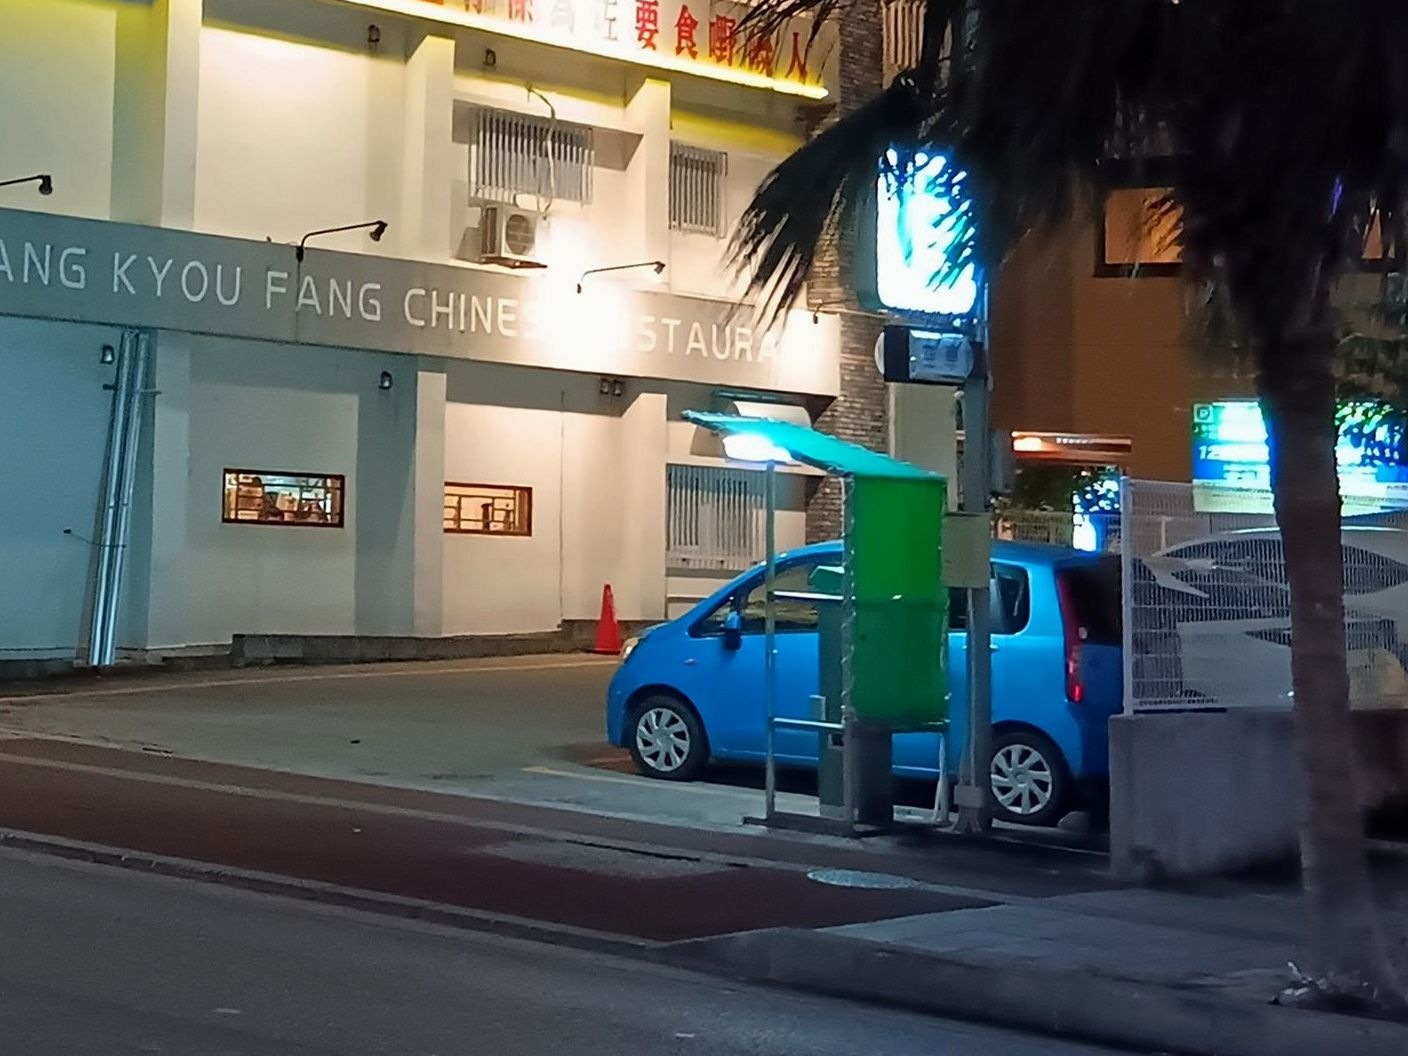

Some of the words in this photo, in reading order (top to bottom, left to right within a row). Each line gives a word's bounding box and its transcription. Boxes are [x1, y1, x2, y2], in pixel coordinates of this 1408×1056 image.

[112, 251, 242, 306] KYOU
[266, 270, 382, 321] FANG
[404, 287, 542, 338] CHINE
